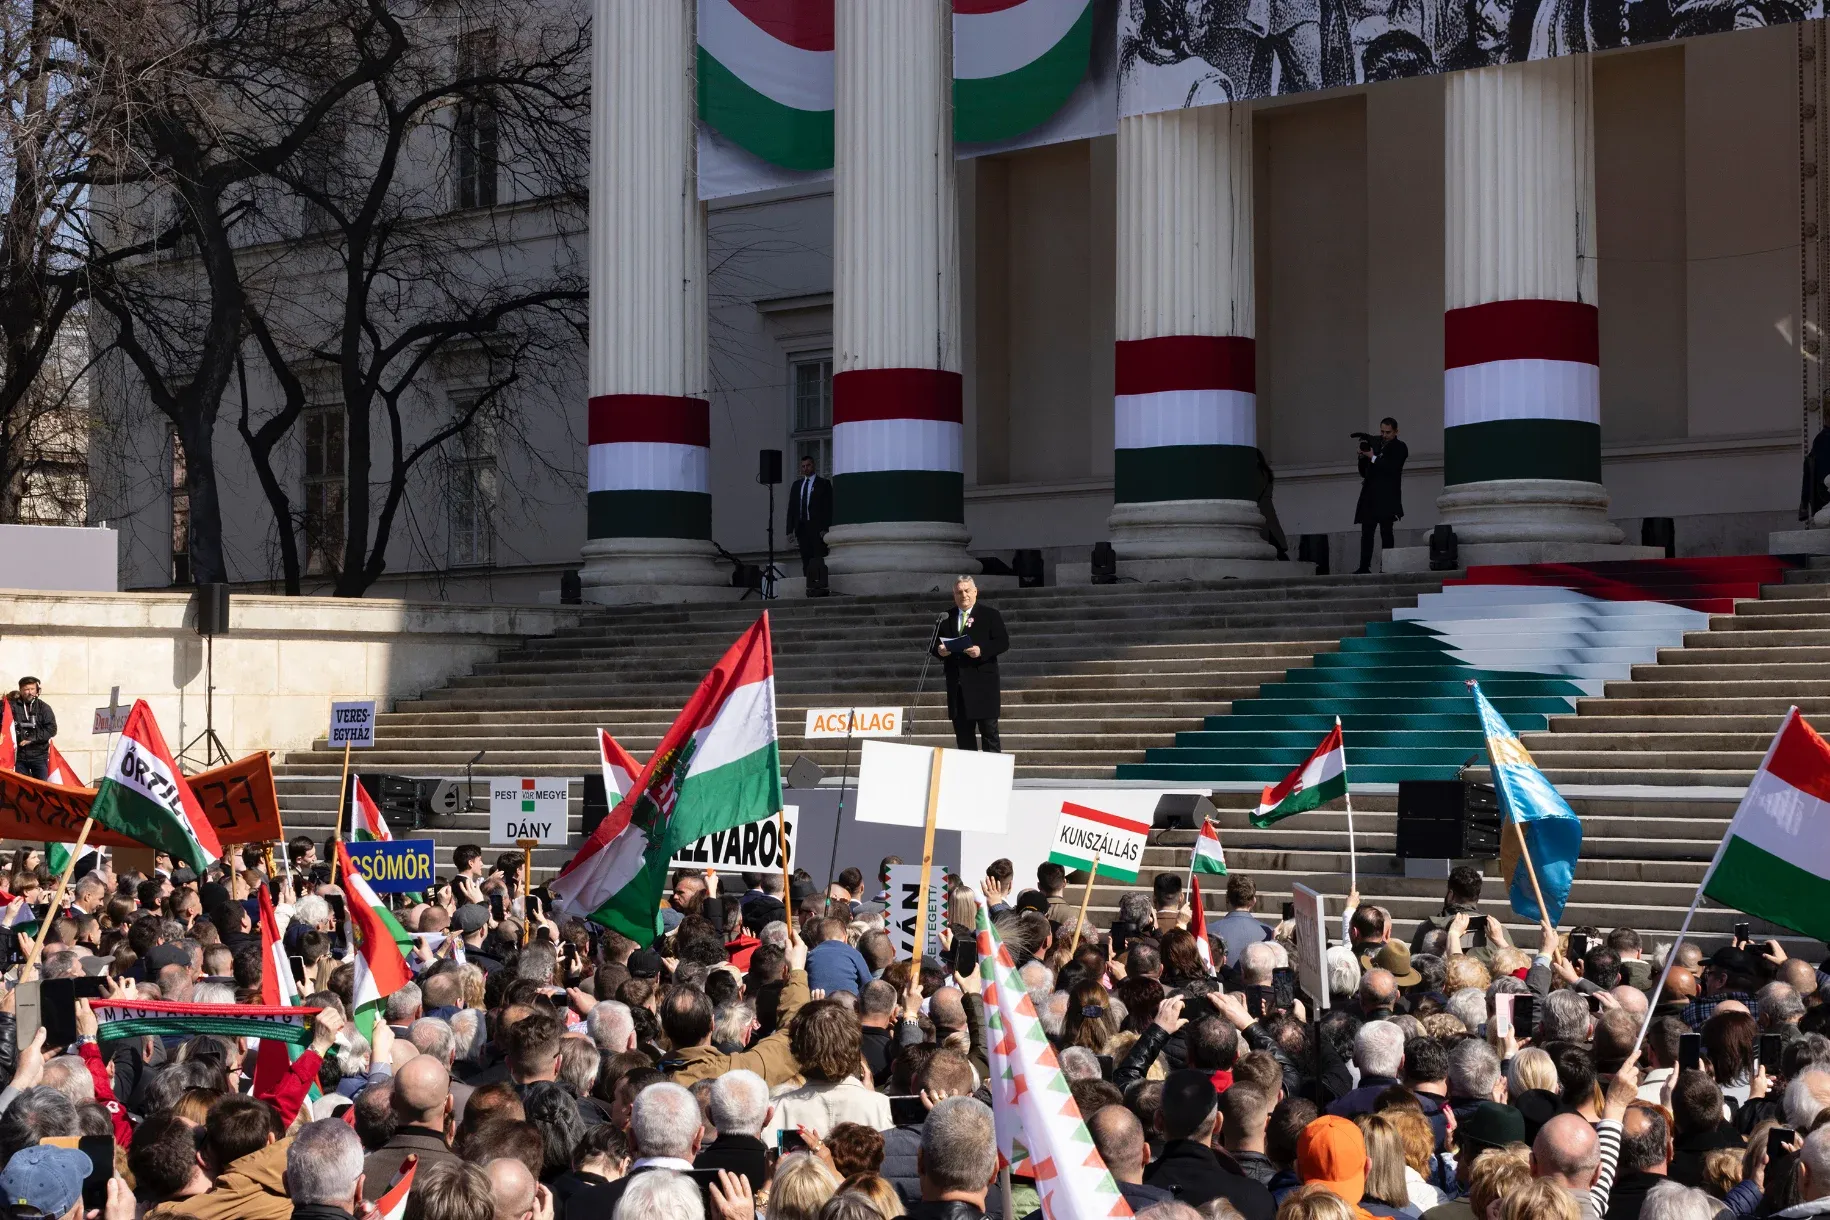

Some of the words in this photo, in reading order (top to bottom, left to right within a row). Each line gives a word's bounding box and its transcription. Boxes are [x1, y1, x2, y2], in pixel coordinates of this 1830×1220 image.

[336, 708, 370, 724] VERES-
[813, 713, 895, 732] ACSALAG
[333, 724, 370, 742] EGYHÁZ
[494, 790, 518, 800] PEST
[507, 818, 552, 838] DÁNY
[1060, 825, 1138, 861] KUNSZÁLLÁS
